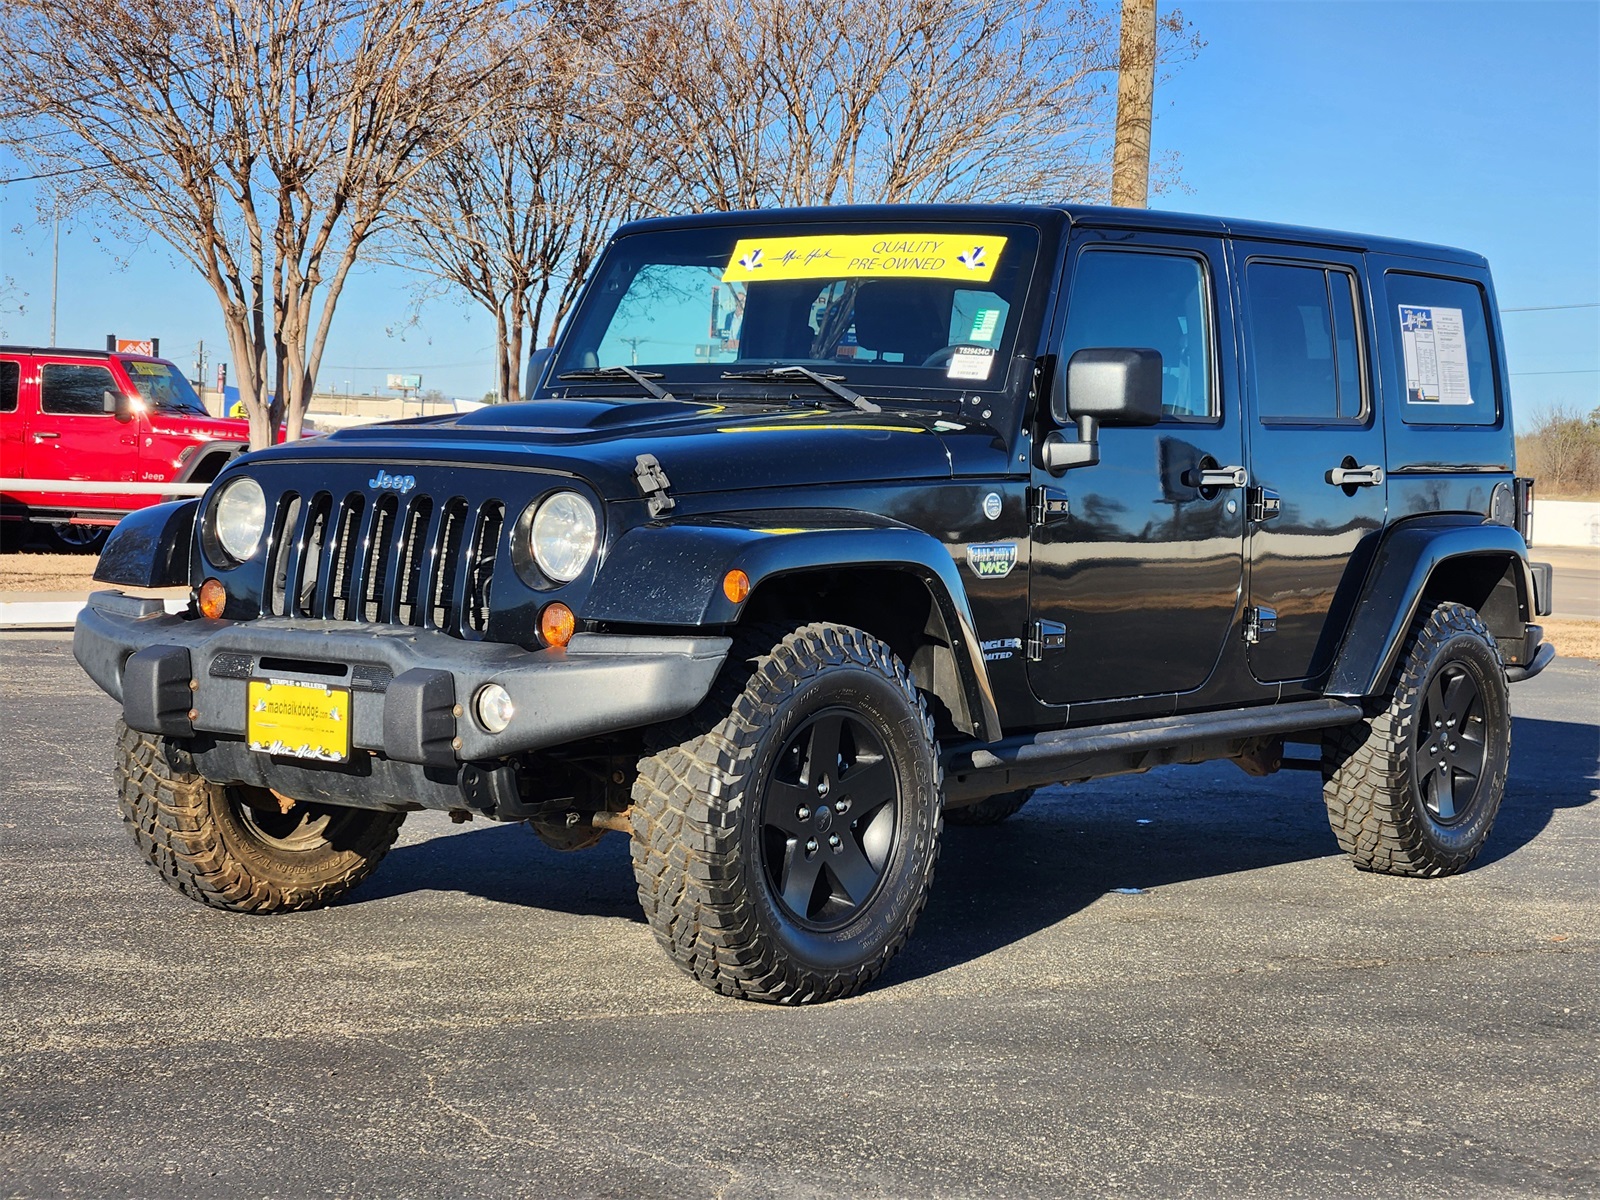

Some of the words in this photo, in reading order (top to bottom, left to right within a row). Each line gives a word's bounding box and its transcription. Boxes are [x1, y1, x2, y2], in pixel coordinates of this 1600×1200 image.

[872, 241, 944, 254] QUALITY
[847, 257, 946, 270] PRE-OWNED
[142, 471, 165, 481] Jeep
[368, 469, 416, 494] Jeep
[269, 678, 295, 686] TEMPLE
[301, 682, 327, 690] KILLEEN
